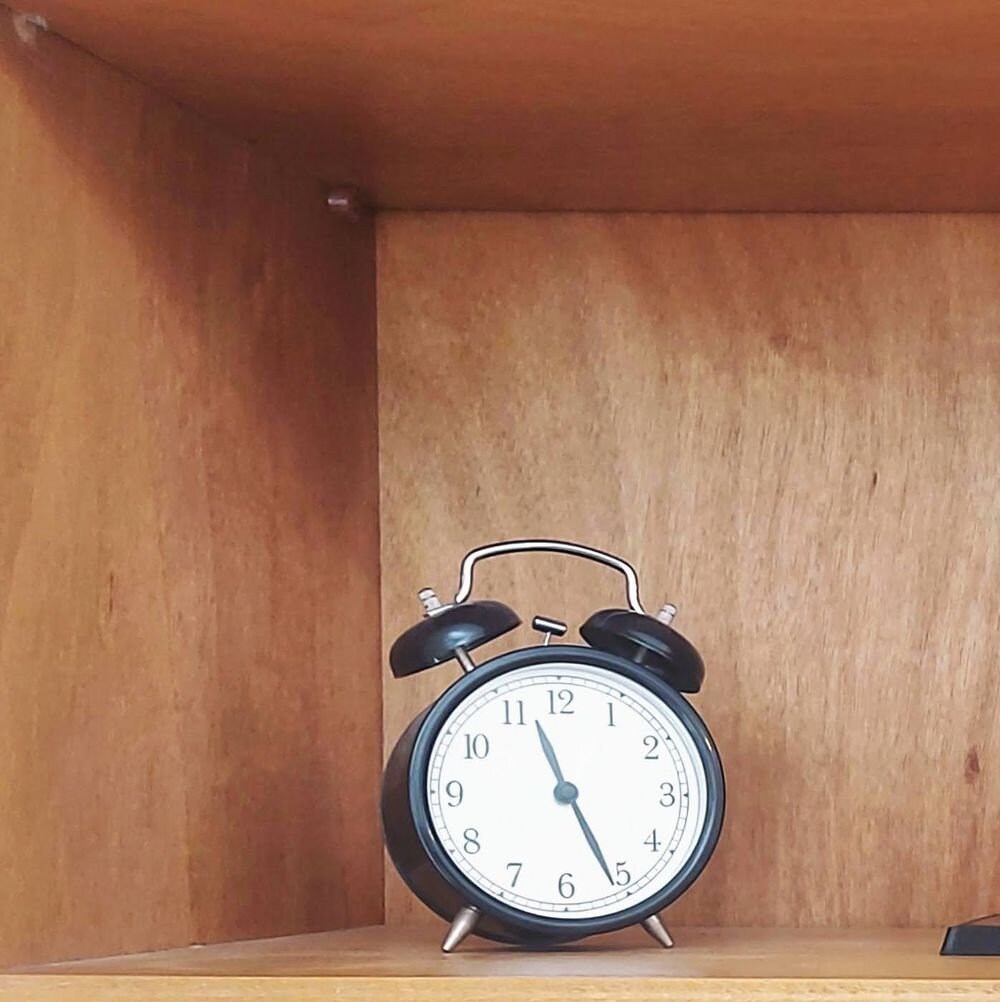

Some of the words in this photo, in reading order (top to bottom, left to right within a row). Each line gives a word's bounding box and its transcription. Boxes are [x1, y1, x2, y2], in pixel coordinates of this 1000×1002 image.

[503, 699, 526, 726] 11
[547, 689, 575, 714] 12
[607, 702, 616, 727] 1
[464, 733, 490, 760] 10
[643, 735, 659, 760] 2
[445, 780, 464, 807] 9
[659, 782, 676, 807] 3
[463, 828, 481, 854] 8
[643, 828, 661, 852] 4
[506, 862, 523, 888] 7
[557, 872, 575, 898] 6
[615, 861, 632, 886] 5
